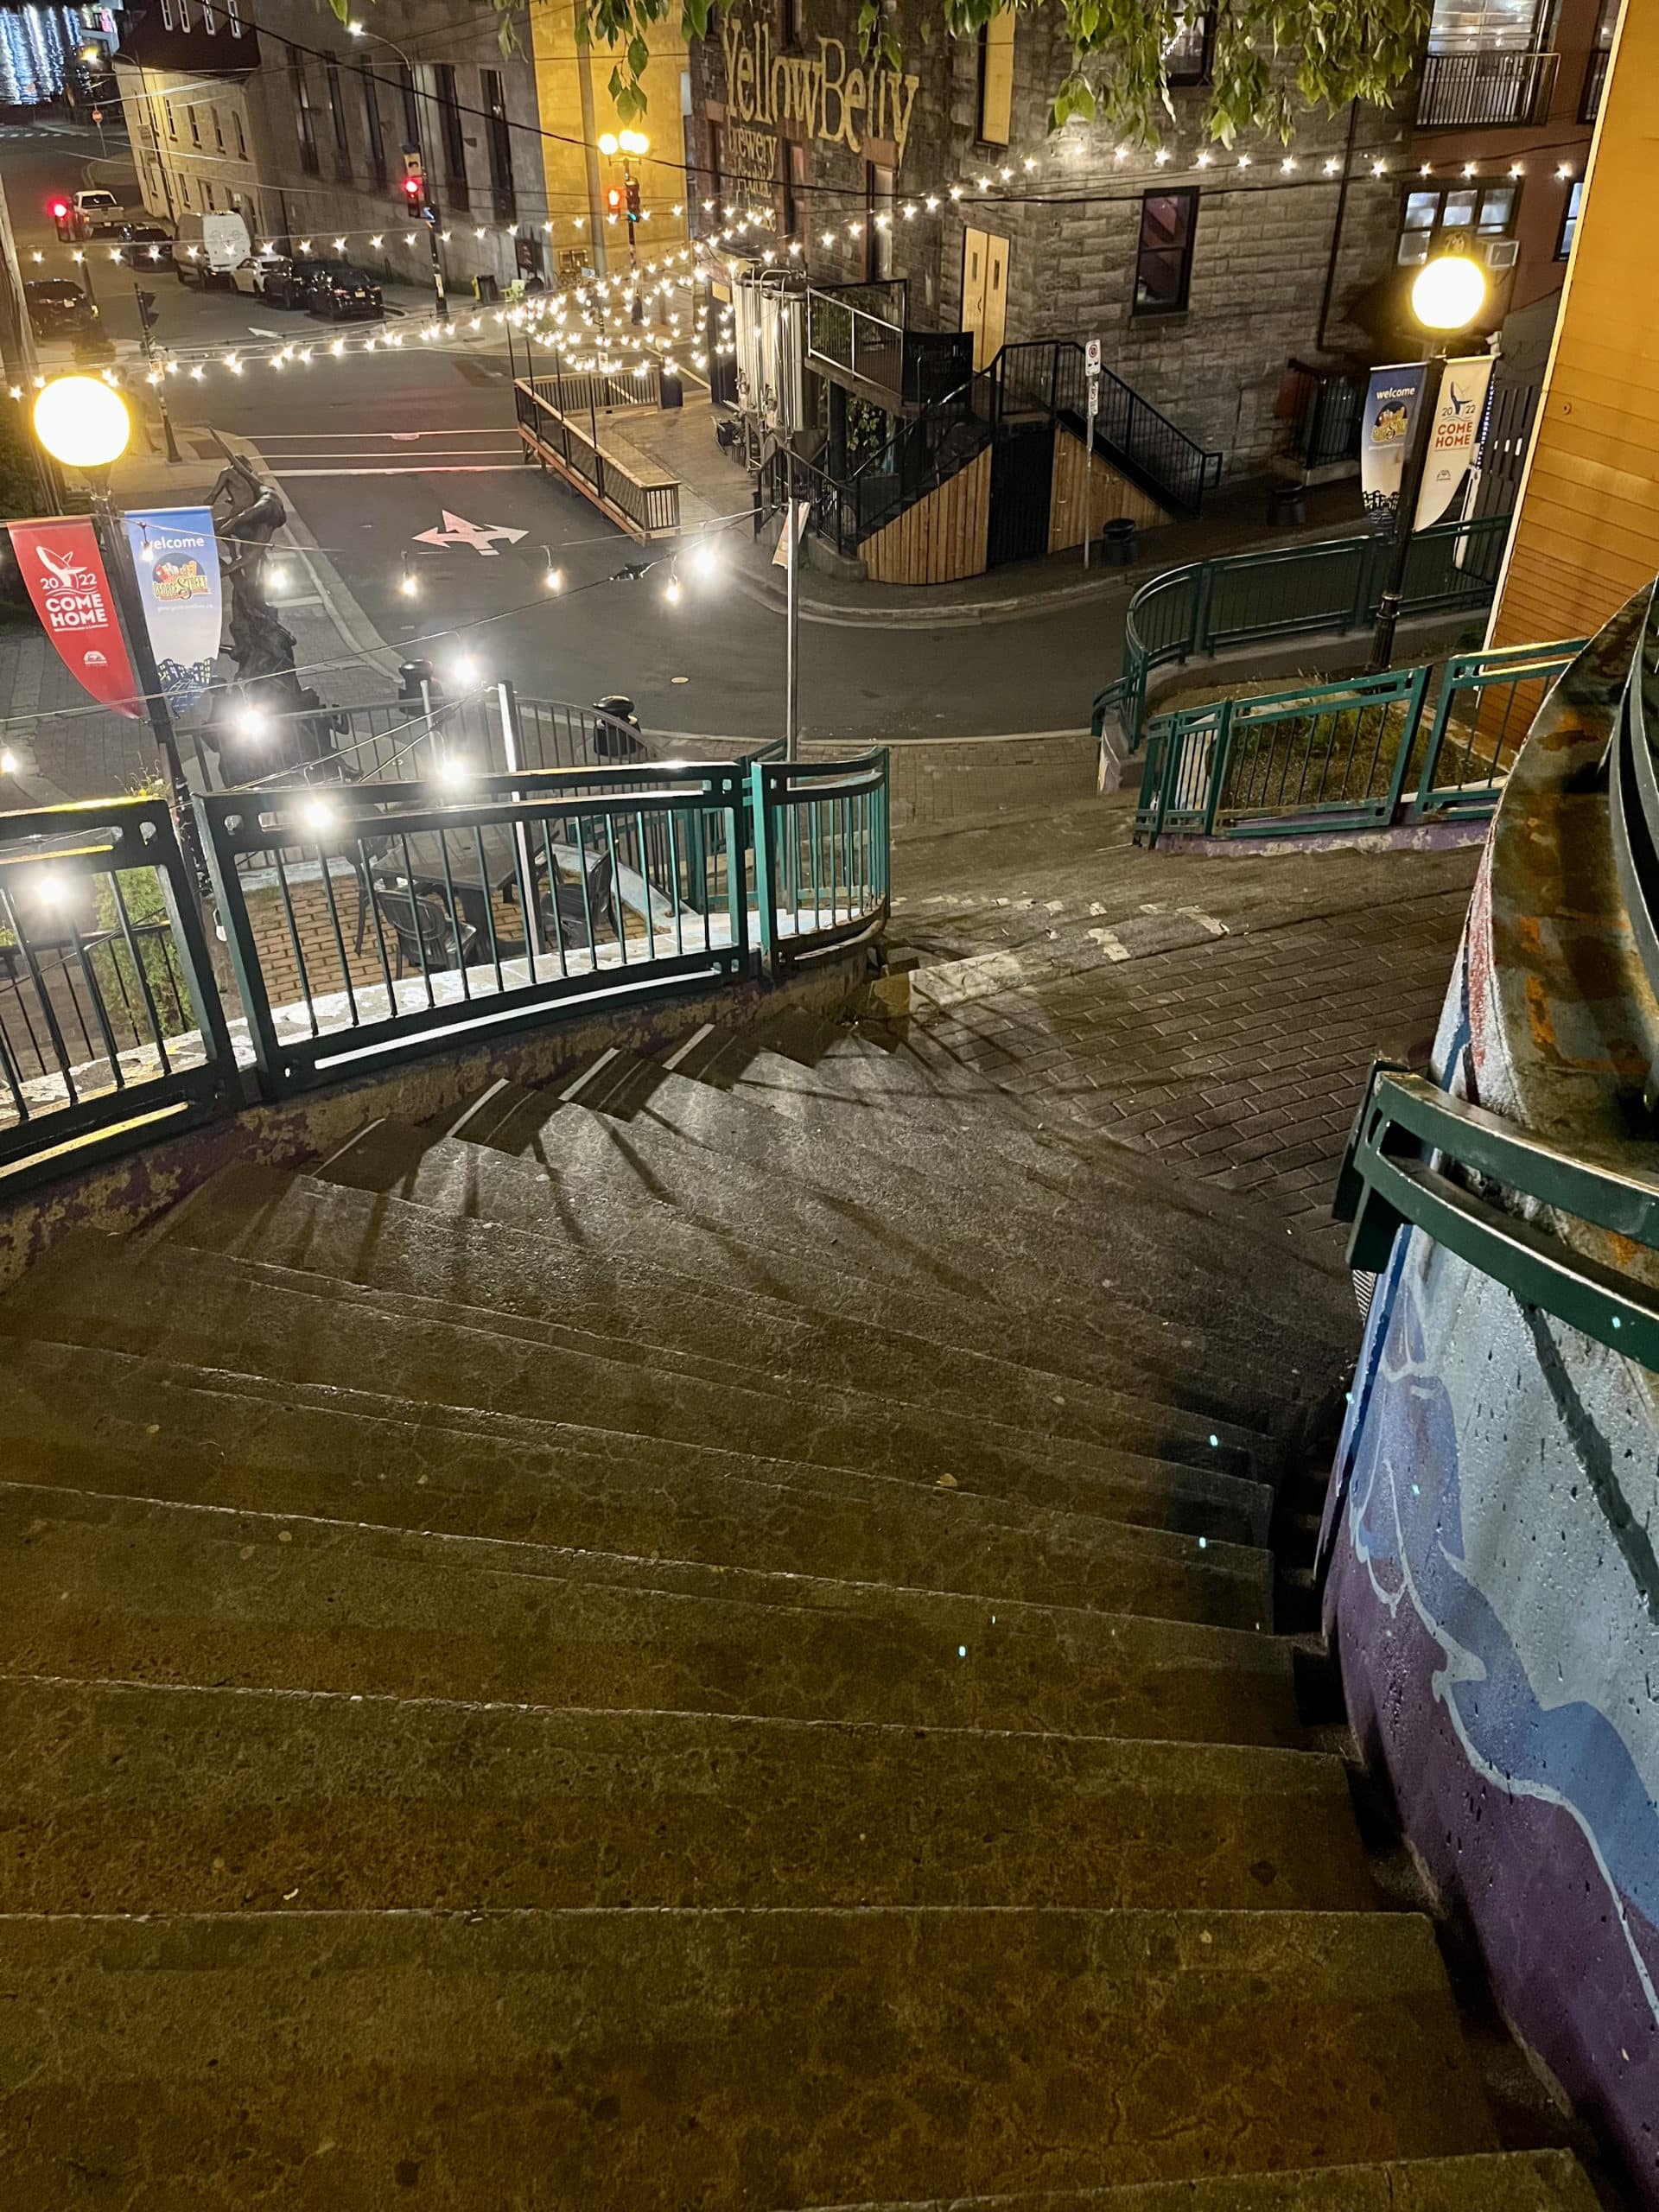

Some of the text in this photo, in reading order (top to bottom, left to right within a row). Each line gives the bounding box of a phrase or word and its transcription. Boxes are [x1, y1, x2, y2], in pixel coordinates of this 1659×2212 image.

[1376, 387, 1415, 400] welcome
[1438, 422, 1473, 435] COME
[1435, 435, 1471, 448] HOME
[46, 593, 105, 613] COME
[50, 608, 108, 627] HOME
